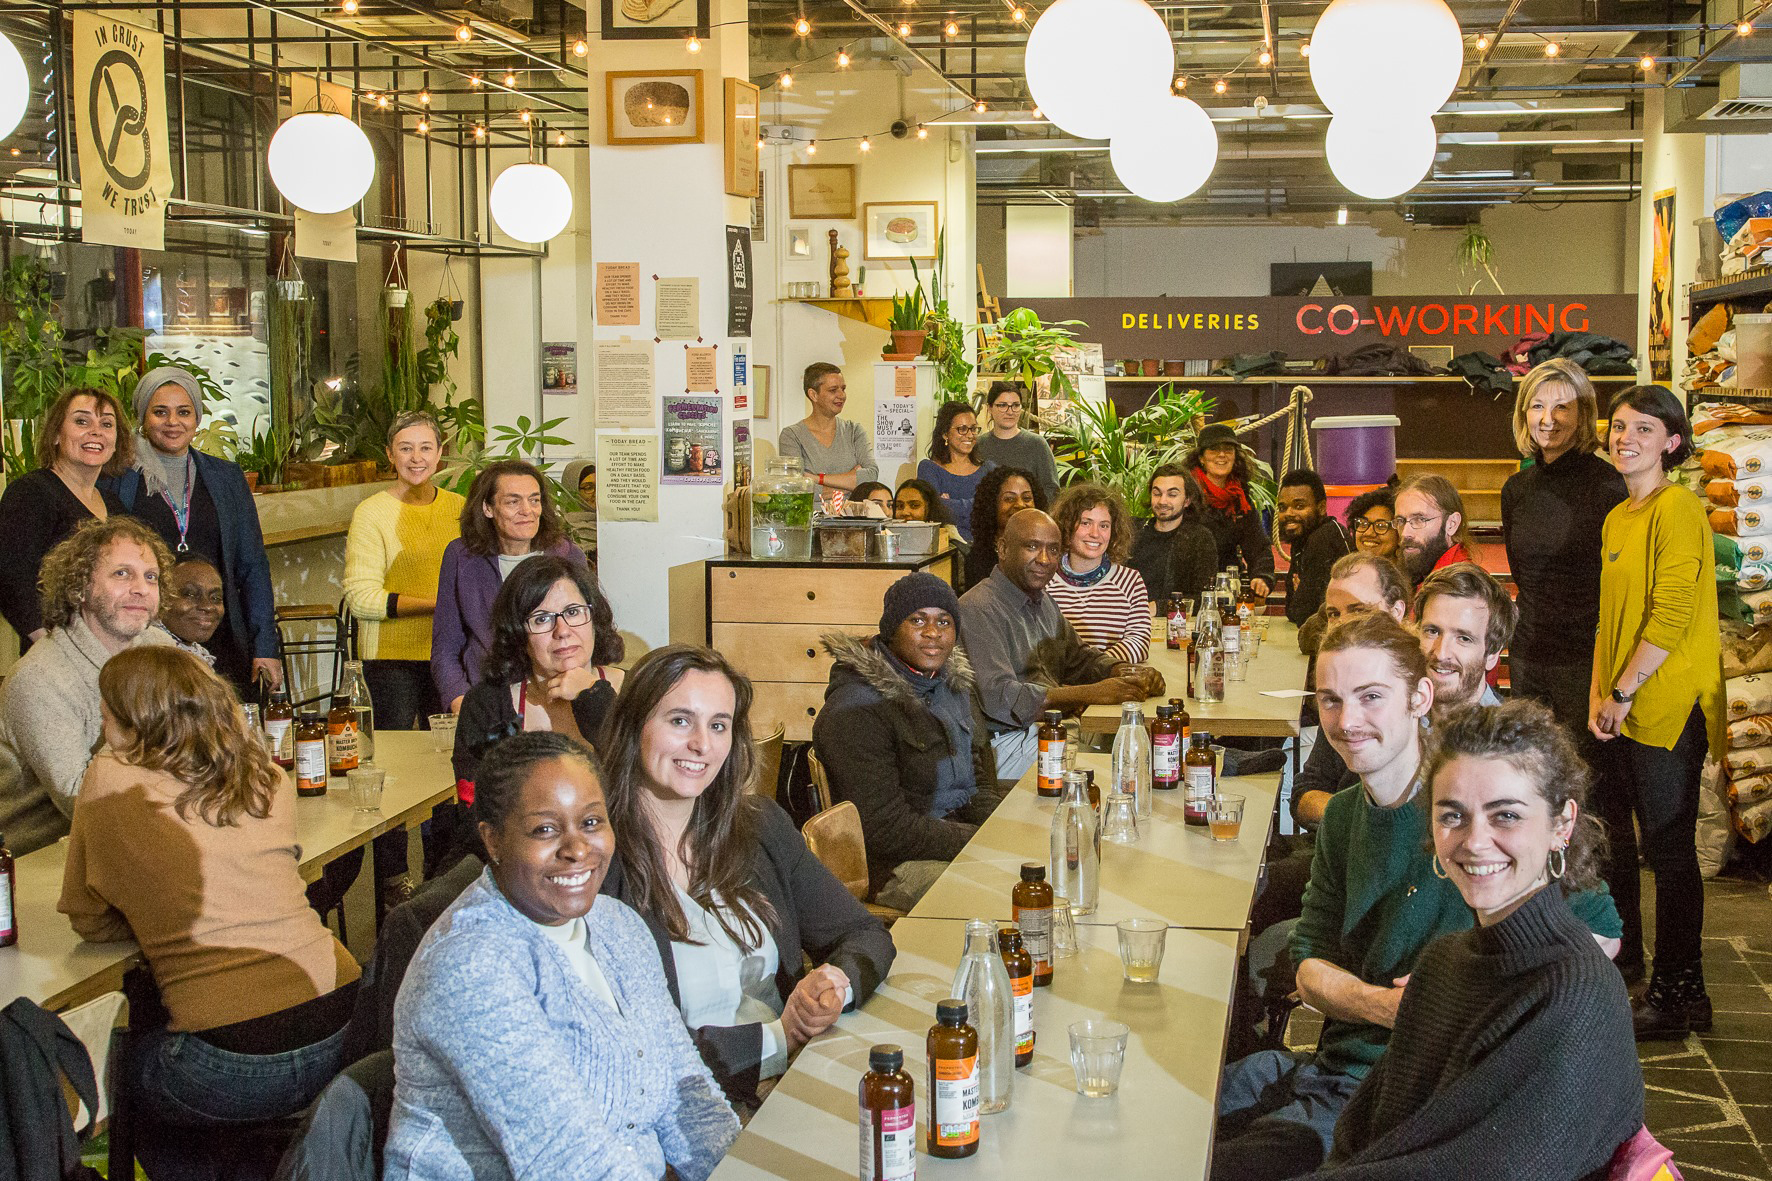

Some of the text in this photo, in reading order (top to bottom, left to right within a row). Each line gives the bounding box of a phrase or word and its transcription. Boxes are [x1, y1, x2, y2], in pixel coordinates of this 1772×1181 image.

[95, 24, 144, 57] IN CRUST
[102, 181, 156, 216] WE TRUST
[1122, 313, 1259, 330] DELIVERIES
[1296, 303, 1589, 337] CO-WORKING
